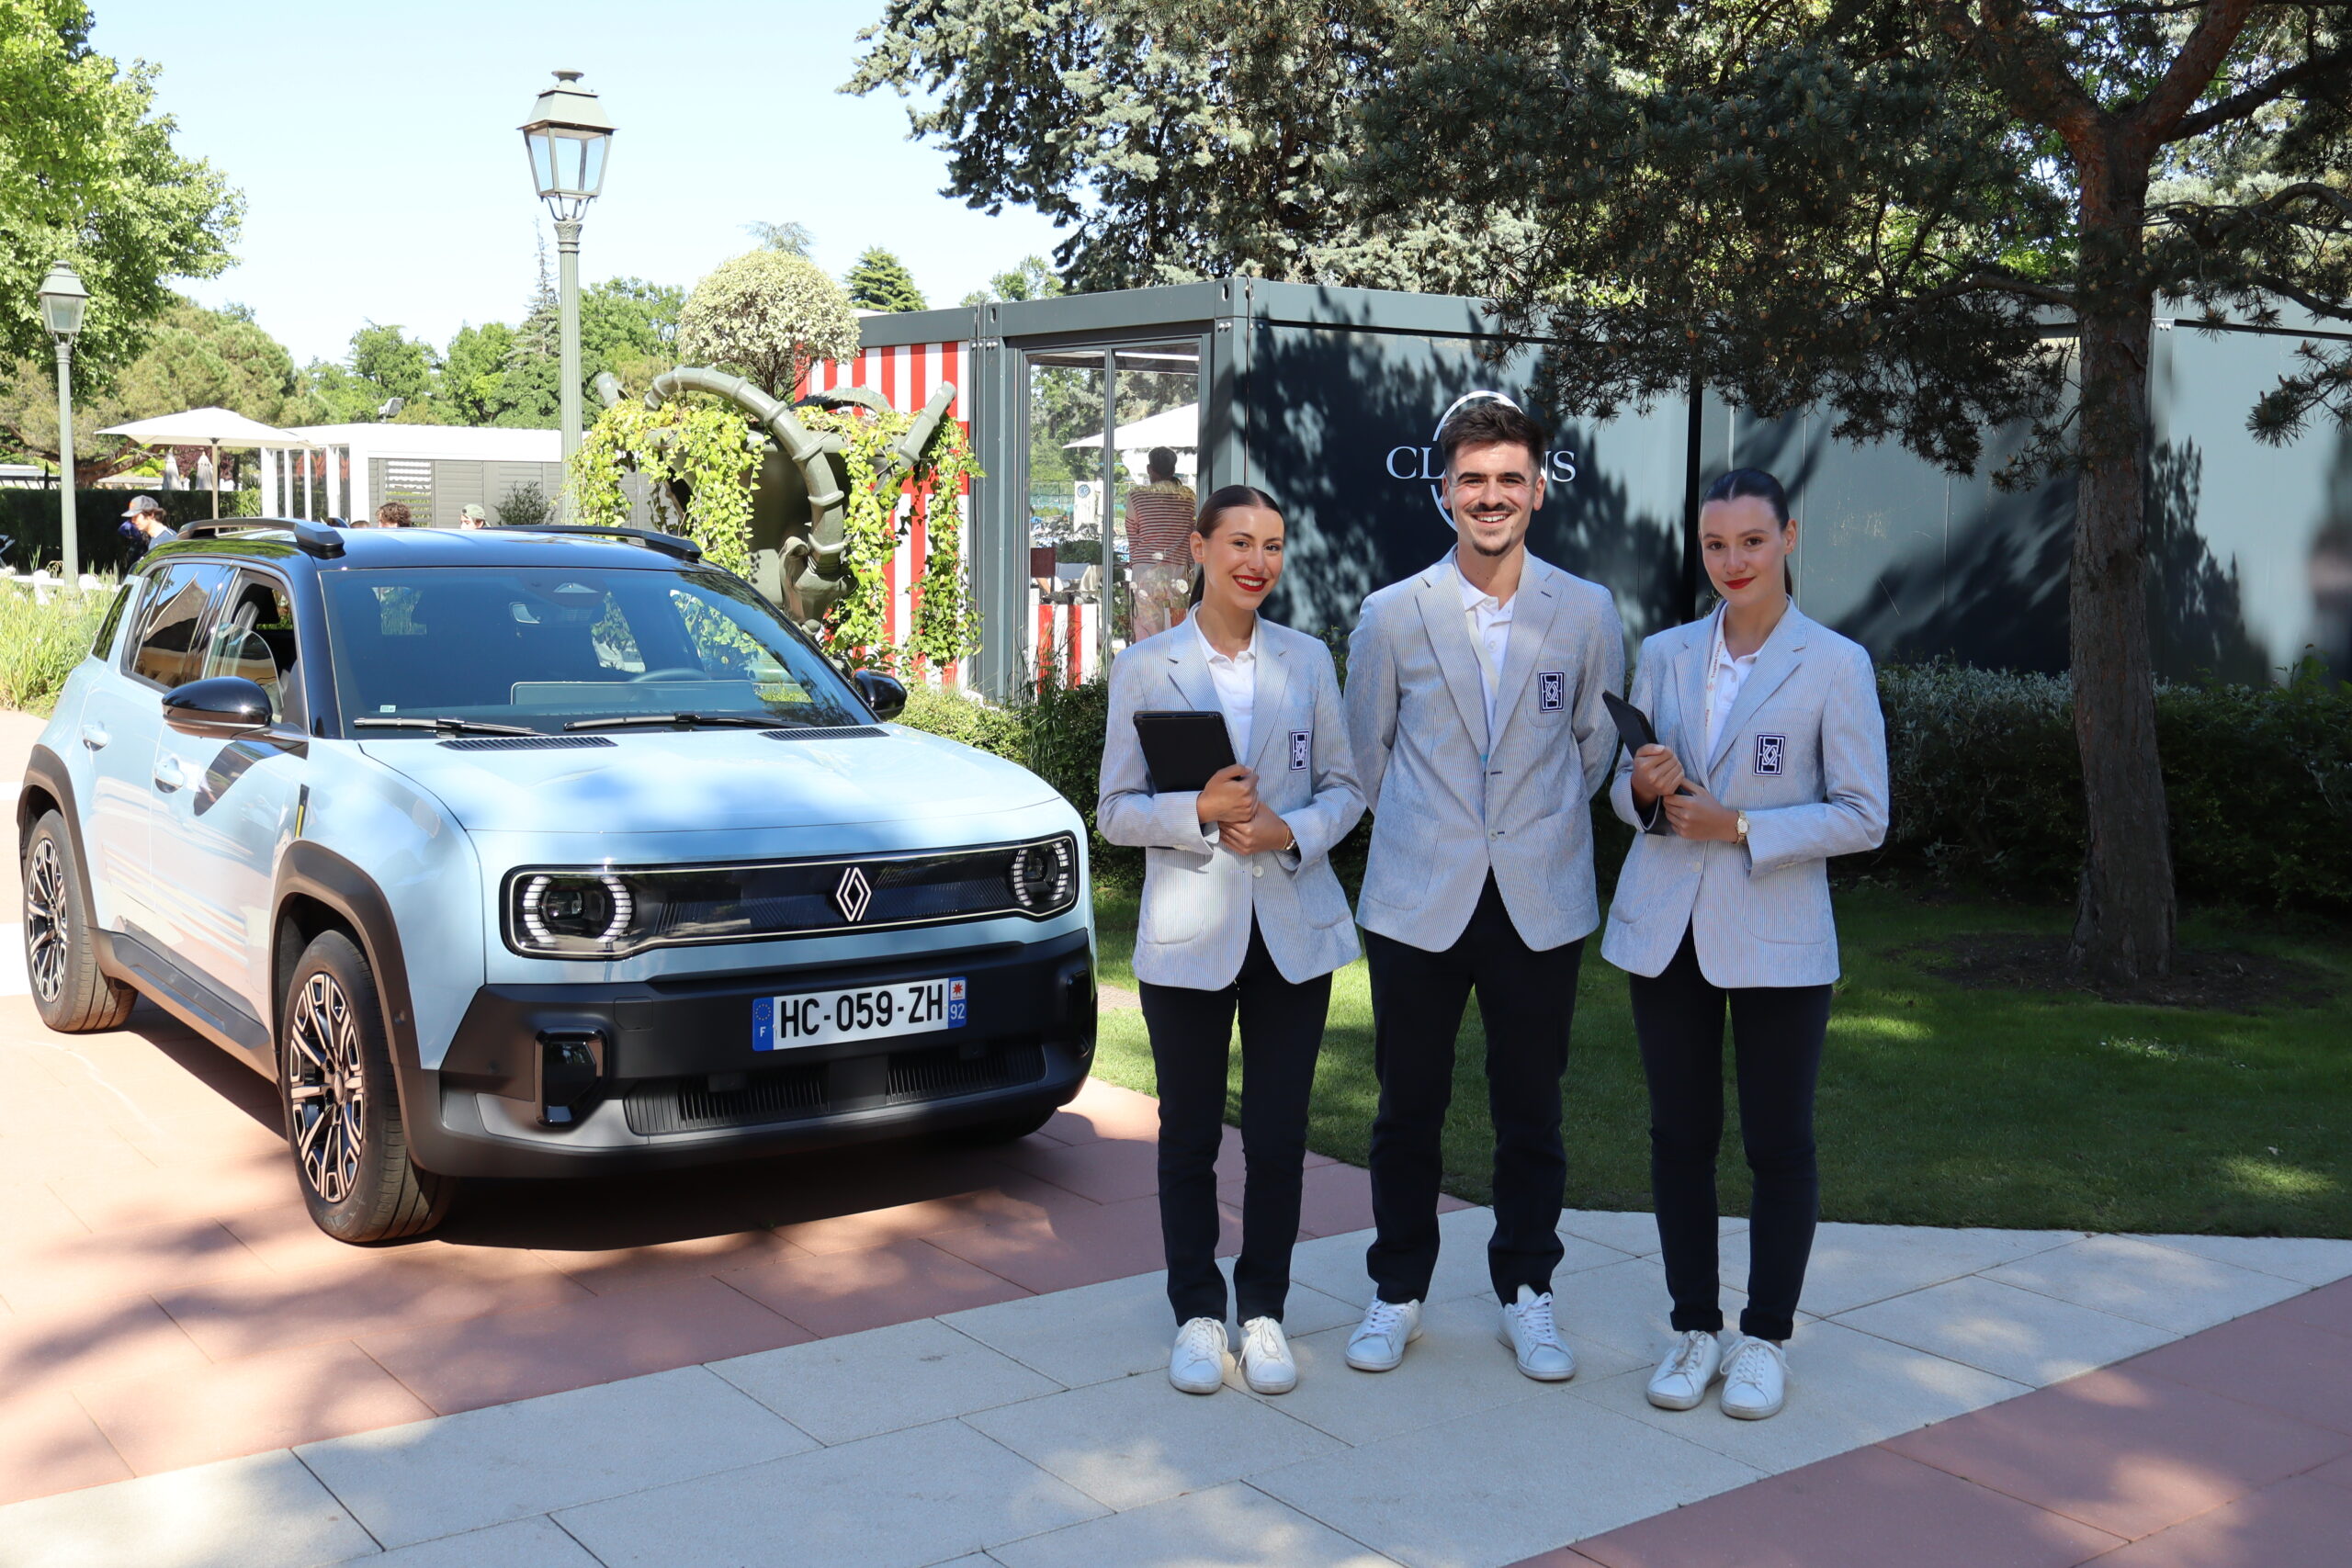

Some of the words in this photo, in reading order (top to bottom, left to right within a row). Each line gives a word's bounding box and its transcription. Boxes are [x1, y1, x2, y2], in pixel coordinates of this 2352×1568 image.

[781, 984, 944, 1038] HC-059-ZH
[950, 1003, 965, 1020] 92
[760, 1026, 766, 1037] F
